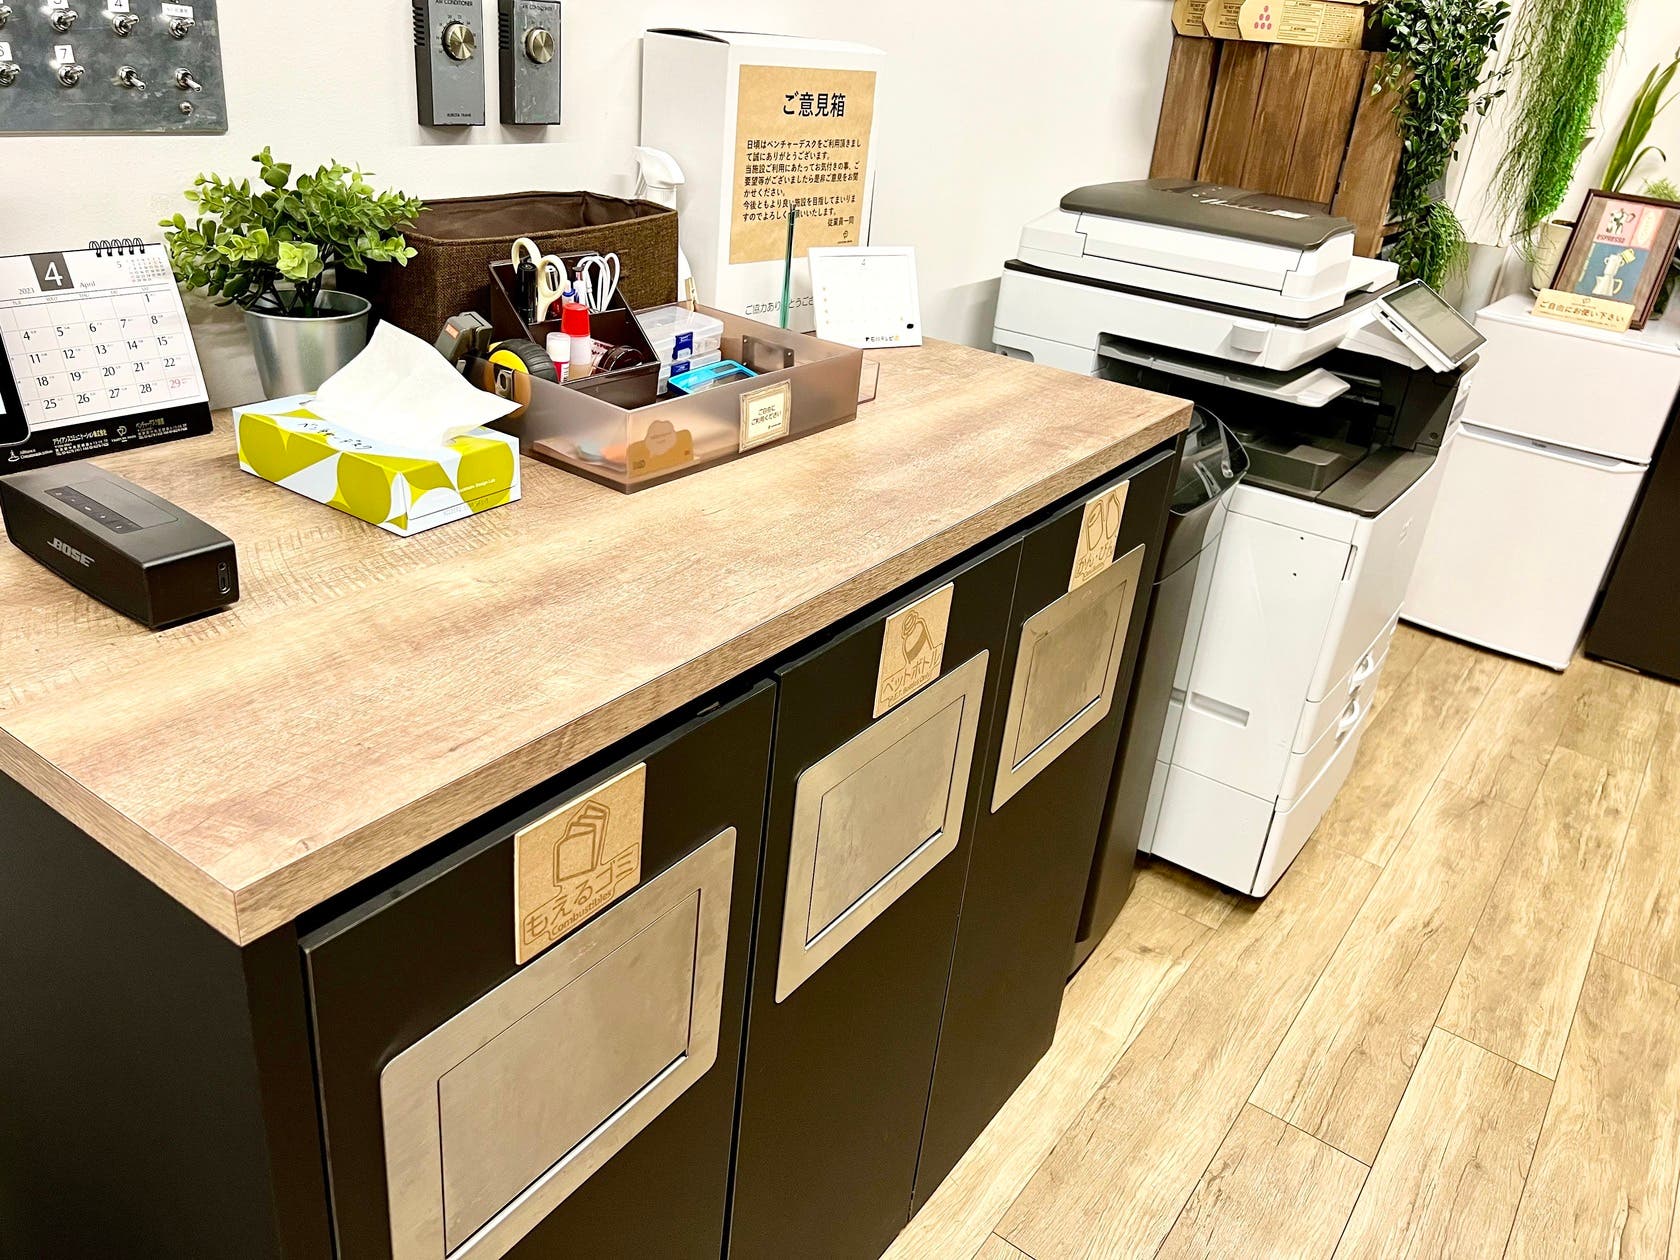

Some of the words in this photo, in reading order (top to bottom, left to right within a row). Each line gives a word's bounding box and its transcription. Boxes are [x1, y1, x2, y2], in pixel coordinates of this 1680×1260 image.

[60, 48, 67, 59] 7
[783, 91, 846, 117] ご意見箱
[746, 151, 830, 161] て誠にありがとうございます。
[747, 139, 861, 149] 日頃はベンチャーデスクをご利用頂きまし
[744, 172, 859, 186] 要望等がございましたら是非ご意見をお聞
[743, 188, 785, 198] かせください。
[44, 261, 63, 287] 4
[80, 280, 96, 289] April
[23, 331, 31, 341] 4
[56, 326, 64, 337] 5
[89, 323, 97, 333] 6
[120, 318, 127, 329] 7
[151, 315, 158, 325] 8
[29, 353, 41, 364] 11
[63, 348, 76, 359] 12
[95, 344, 107, 355] 13
[127, 340, 138, 350] 14
[157, 336, 168, 346] 15
[36, 376, 49, 387] 18
[70, 371, 82, 382] 19
[102, 366, 116, 377] 20
[134, 362, 145, 372] 21
[163, 357, 176, 368] 22
[43, 398, 57, 410] 25
[76, 393, 90, 404] 26
[109, 388, 120, 399] 27
[139, 383, 152, 394] 28
[169, 378, 181, 389] 29
[46, 536, 96, 568] BOSE
[525, 849, 635, 938] もえるゴミ
